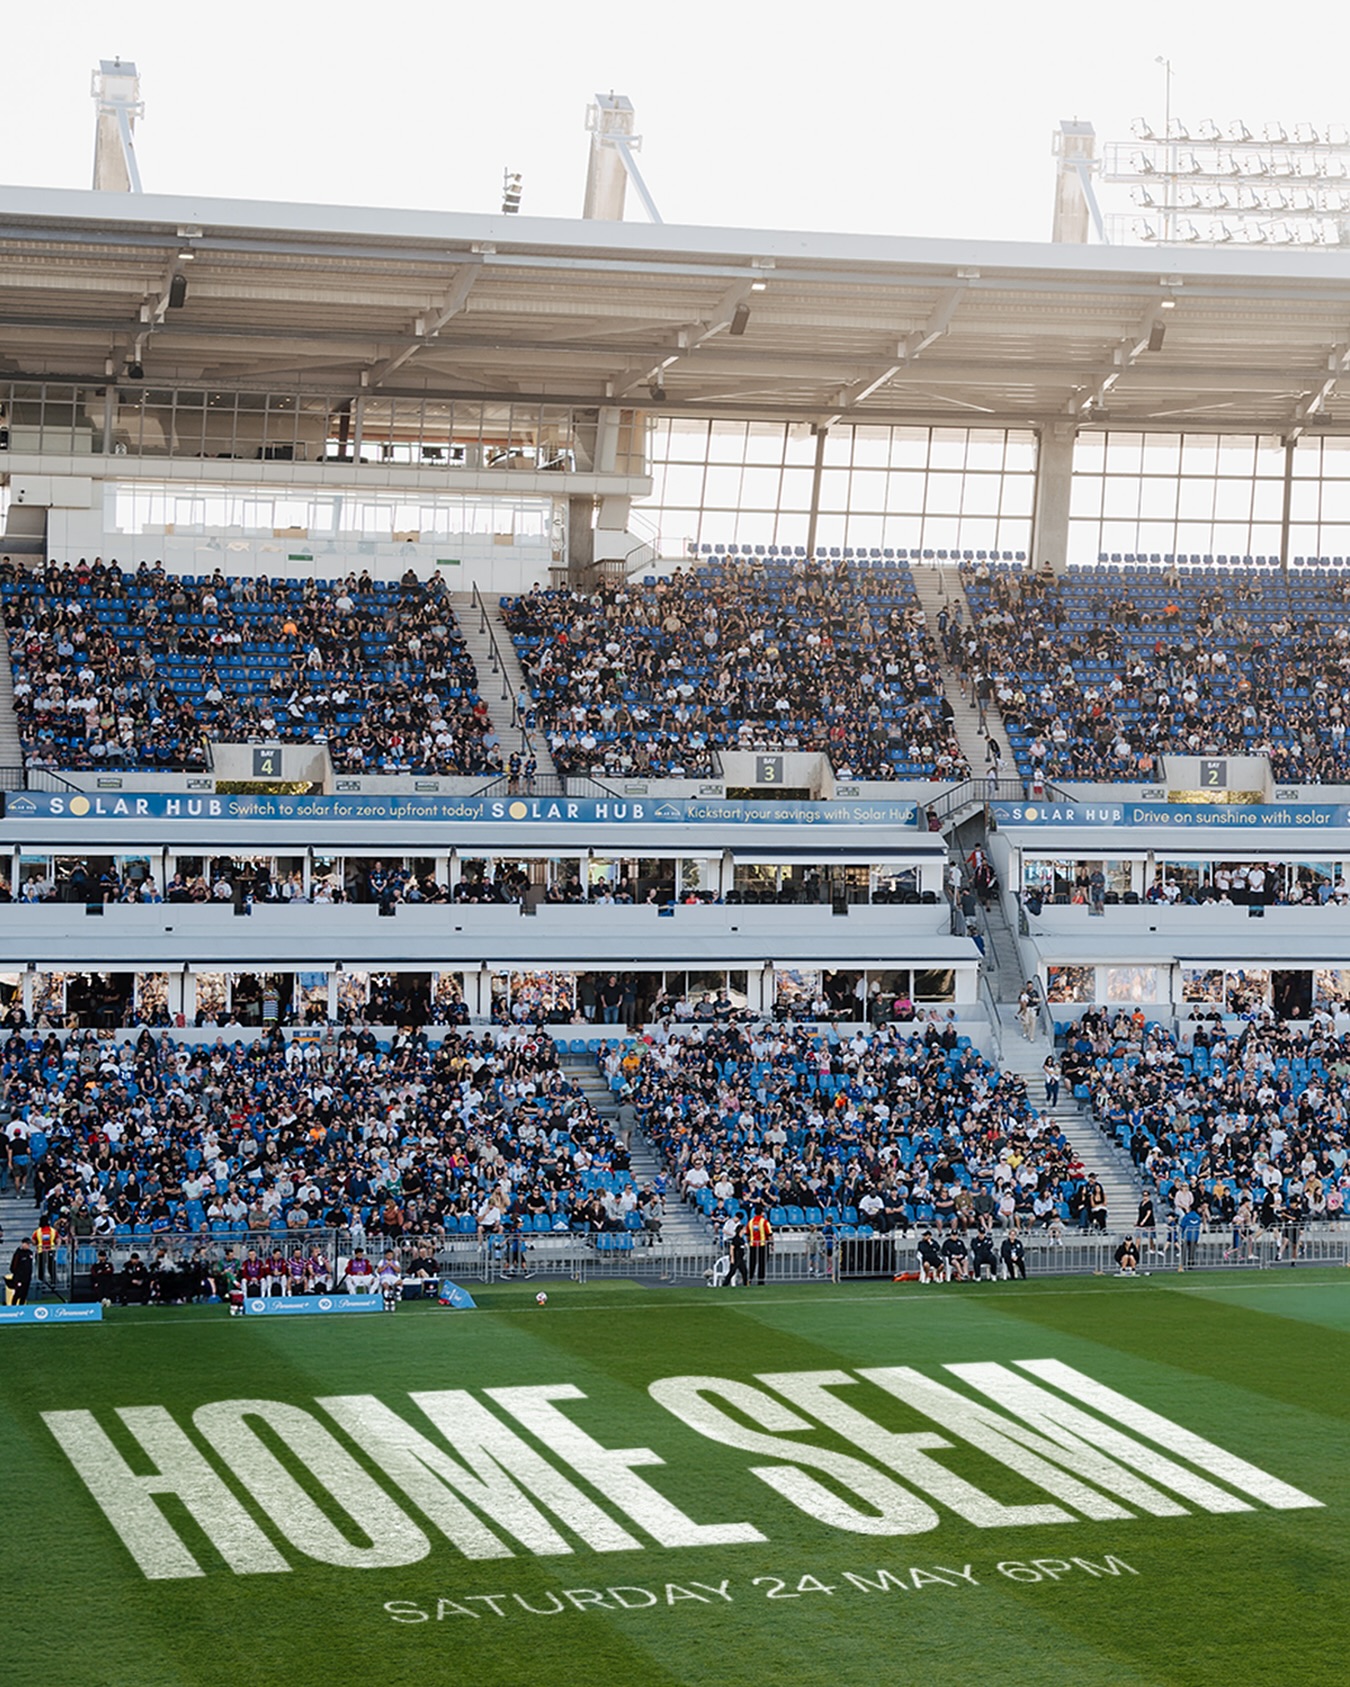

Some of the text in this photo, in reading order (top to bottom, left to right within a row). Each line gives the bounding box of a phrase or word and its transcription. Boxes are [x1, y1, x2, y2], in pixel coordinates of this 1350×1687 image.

[261, 758, 273, 775] 4
[764, 765, 775, 781] 3
[1208, 769, 1219, 785] 2
[50, 795, 149, 816] SOLAR
[167, 799, 222, 816] HUB
[228, 801, 484, 820] Switch to solar for zero upfront today!
[491, 801, 579, 820] SOLAR
[595, 803, 644, 819] HUB
[1012, 807, 1075, 821] SOLAR
[1086, 808, 1121, 820] HUB
[687, 806, 741, 818] Kickstart
[744, 807, 771, 822] your
[774, 807, 821, 823] savings
[824, 807, 850, 820] with
[853, 807, 886, 821] Solar
[889, 808, 914, 821] Hub
[1133, 808, 1170, 823] Drive
[1174, 812, 1192, 824] on
[1196, 809, 1257, 824] sunshine
[1261, 810, 1291, 824] with
[1295, 809, 1330, 824] solar
